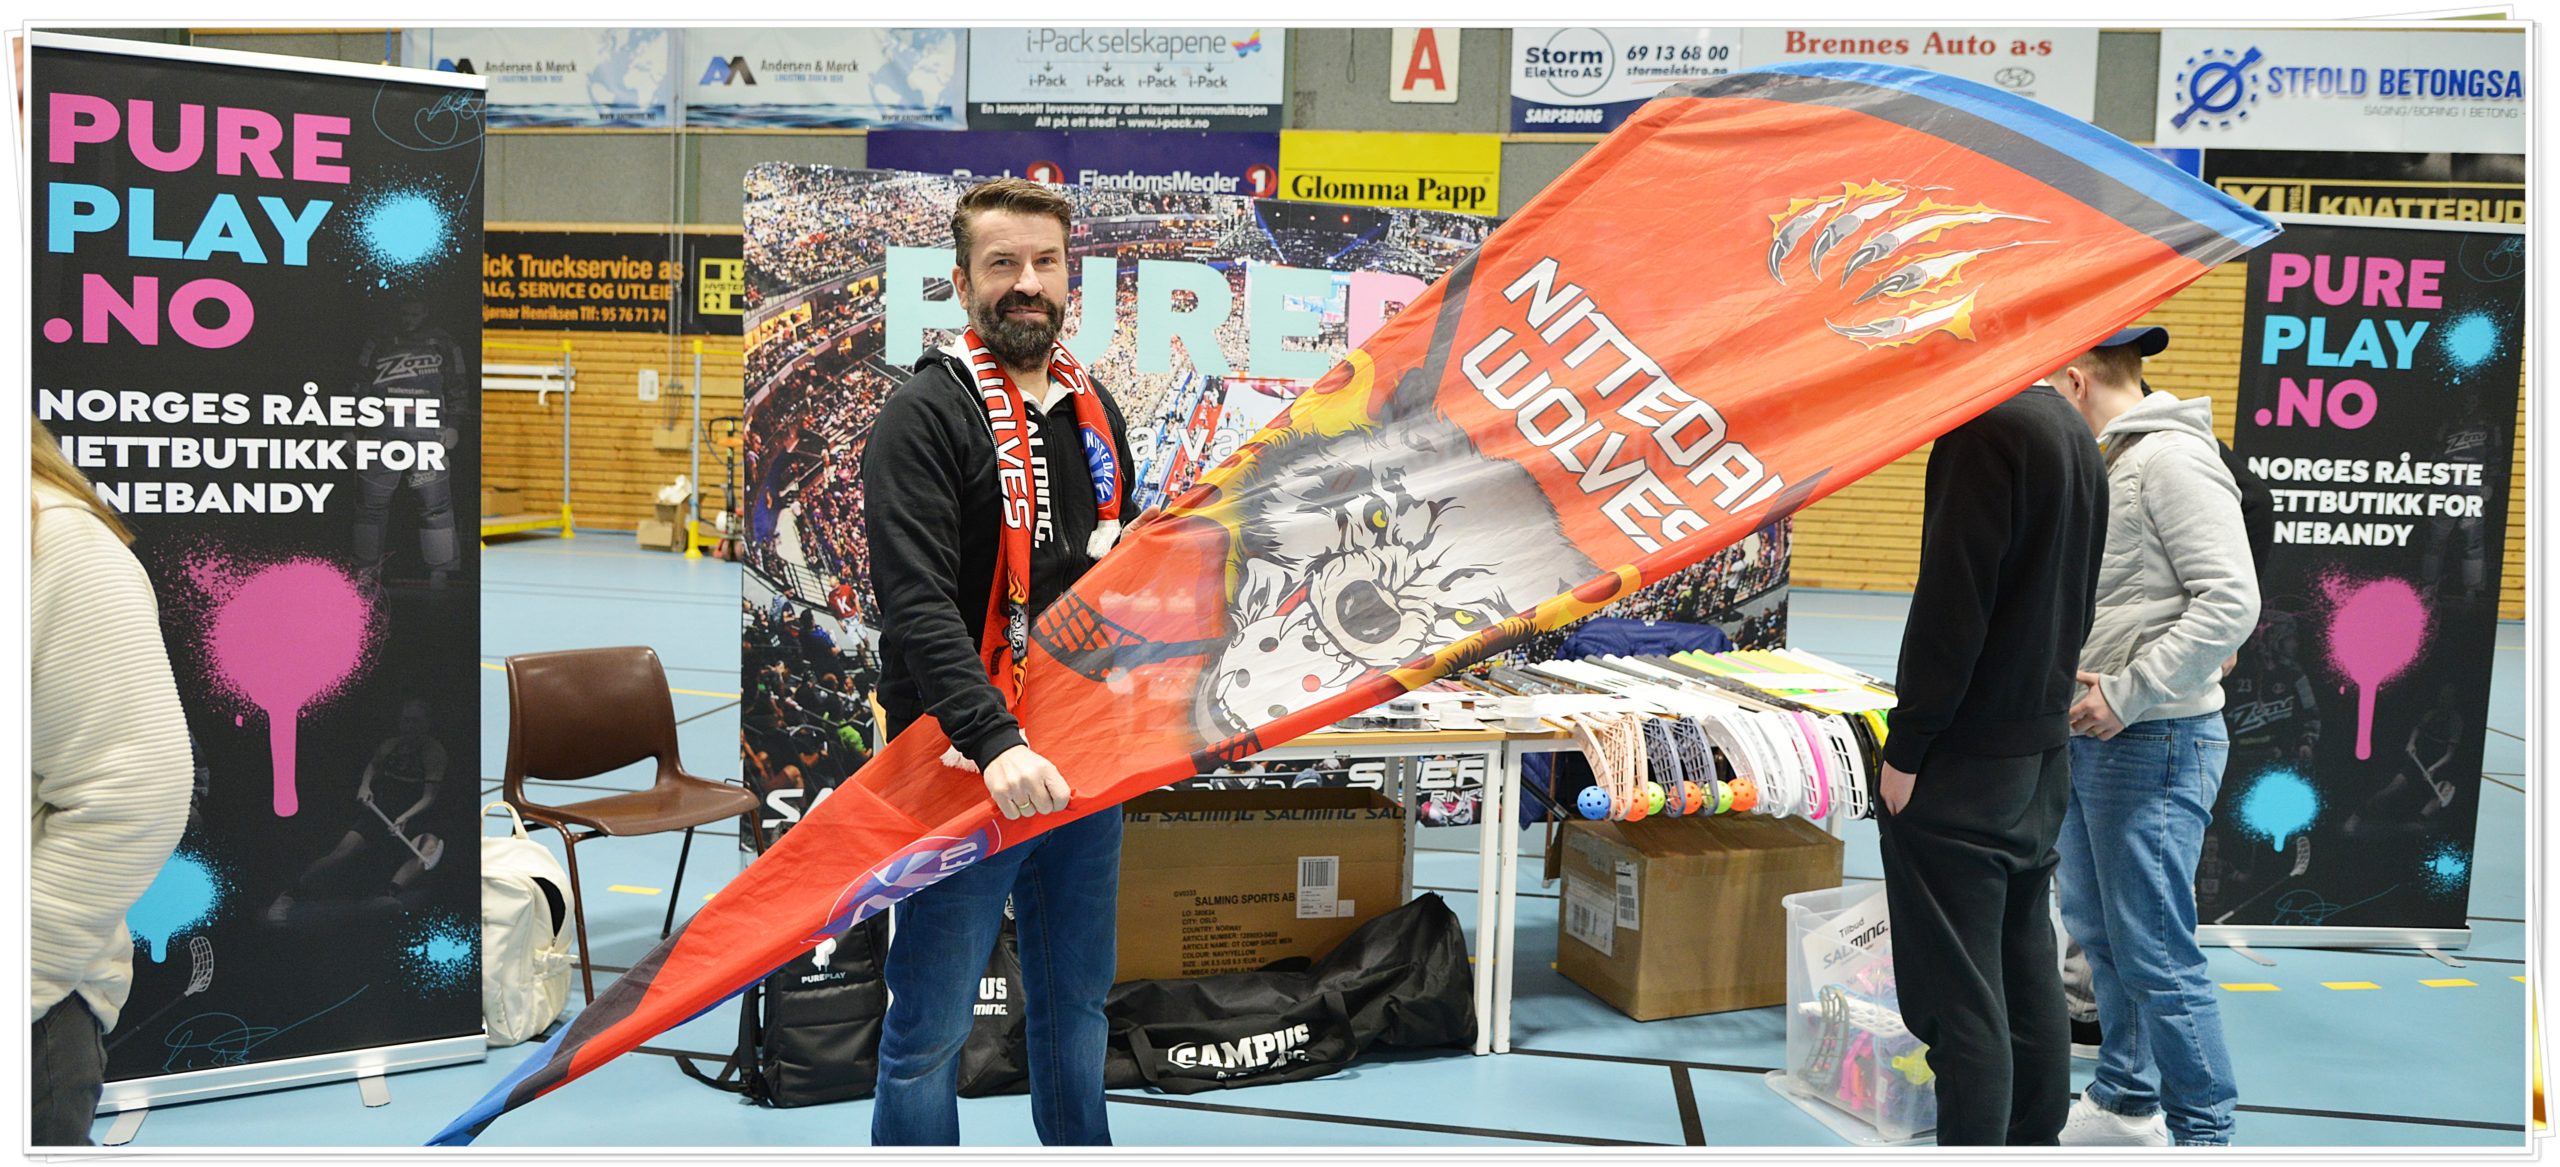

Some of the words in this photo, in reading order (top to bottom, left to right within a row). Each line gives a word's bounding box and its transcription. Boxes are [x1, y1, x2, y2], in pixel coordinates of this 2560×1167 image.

[1026, 28, 1094, 54] i-Pack
[1098, 28, 1226, 60] selskapene
[1627, 46, 1648, 61] 69
[1655, 46, 1675, 61] 13
[1681, 46, 1701, 61] 68
[1708, 46, 1729, 61] 00
[1785, 30, 1910, 55] Brennes
[1923, 31, 1997, 56] Auto
[761, 59, 812, 73] Andersen
[815, 60, 822, 72] &
[1403, 28, 1447, 92] A
[1525, 46, 1603, 64] Storm
[485, 60, 533, 73] Andersen
[1525, 67, 1579, 78] Elektro
[1583, 67, 1602, 78] AS
[1029, 74, 1066, 87] i-Pack
[1087, 74, 1125, 87] i-Pack
[1138, 74, 1176, 87] i-Pack
[1189, 74, 1227, 88] i-Pack
[2379, 69, 2525, 99] BETONGSA
[981, 104, 994, 114] En
[1107, 107, 1122, 116] av
[1179, 105, 1268, 119] kommunikasjon
[1525, 109, 1604, 124] SARPSBORG
[2470, 106, 2518, 118] BETONG
[1053, 117, 1069, 130] på
[1128, 118, 1210, 130] www.i-pack.no
[47, 92, 351, 185] PURE
[1292, 174, 1409, 202] Glomma
[1418, 177, 1488, 209] Papp
[2318, 195, 2525, 225] KNATTERUD
[47, 182, 333, 267] PLAY
[483, 254, 515, 278] ick
[518, 253, 653, 280] Truckservice
[658, 260, 684, 282] as
[483, 281, 515, 300] ALG,
[518, 281, 586, 299] SERVICE
[589, 282, 614, 299] OG
[617, 282, 673, 300] UTLEIE
[2267, 252, 2446, 309] PURE
[43, 273, 255, 349] .NO
[521, 305, 578, 321] Henriksen
[580, 305, 600, 321] Tlf:
[602, 307, 616, 322] 95
[619, 307, 633, 322] 76
[635, 307, 649, 322] 71
[652, 308, 666, 322] 74
[2261, 314, 2430, 370] PLAY
[38, 388, 250, 425] NORGES
[263, 381, 440, 428] RÅESTE
[2255, 377, 2378, 430] .NO
[356, 440, 445, 471] FOR
[1026, 408, 1054, 549] ALMING.
[2248, 456, 2370, 484] NORGES
[2375, 452, 2483, 487] RÅESTE
[93, 482, 334, 514] NEBANDY
[2270, 489, 2423, 516] ETTBUTIKK
[2427, 494, 2483, 517] FOR
[2273, 521, 2414, 547] NEBANDY
[1195, 895, 1239, 906] SALMING
[1241, 893, 1280, 905] SPORTS
[1282, 892, 1296, 902] AB
[1182, 926, 1213, 934] COUNTRY:
[1182, 934, 1208, 942] ARTICLE
[1838, 917, 1866, 939] Tilbud
[1182, 943, 1208, 951] ARTICLE
[801, 971, 846, 984] PUREPLAY
